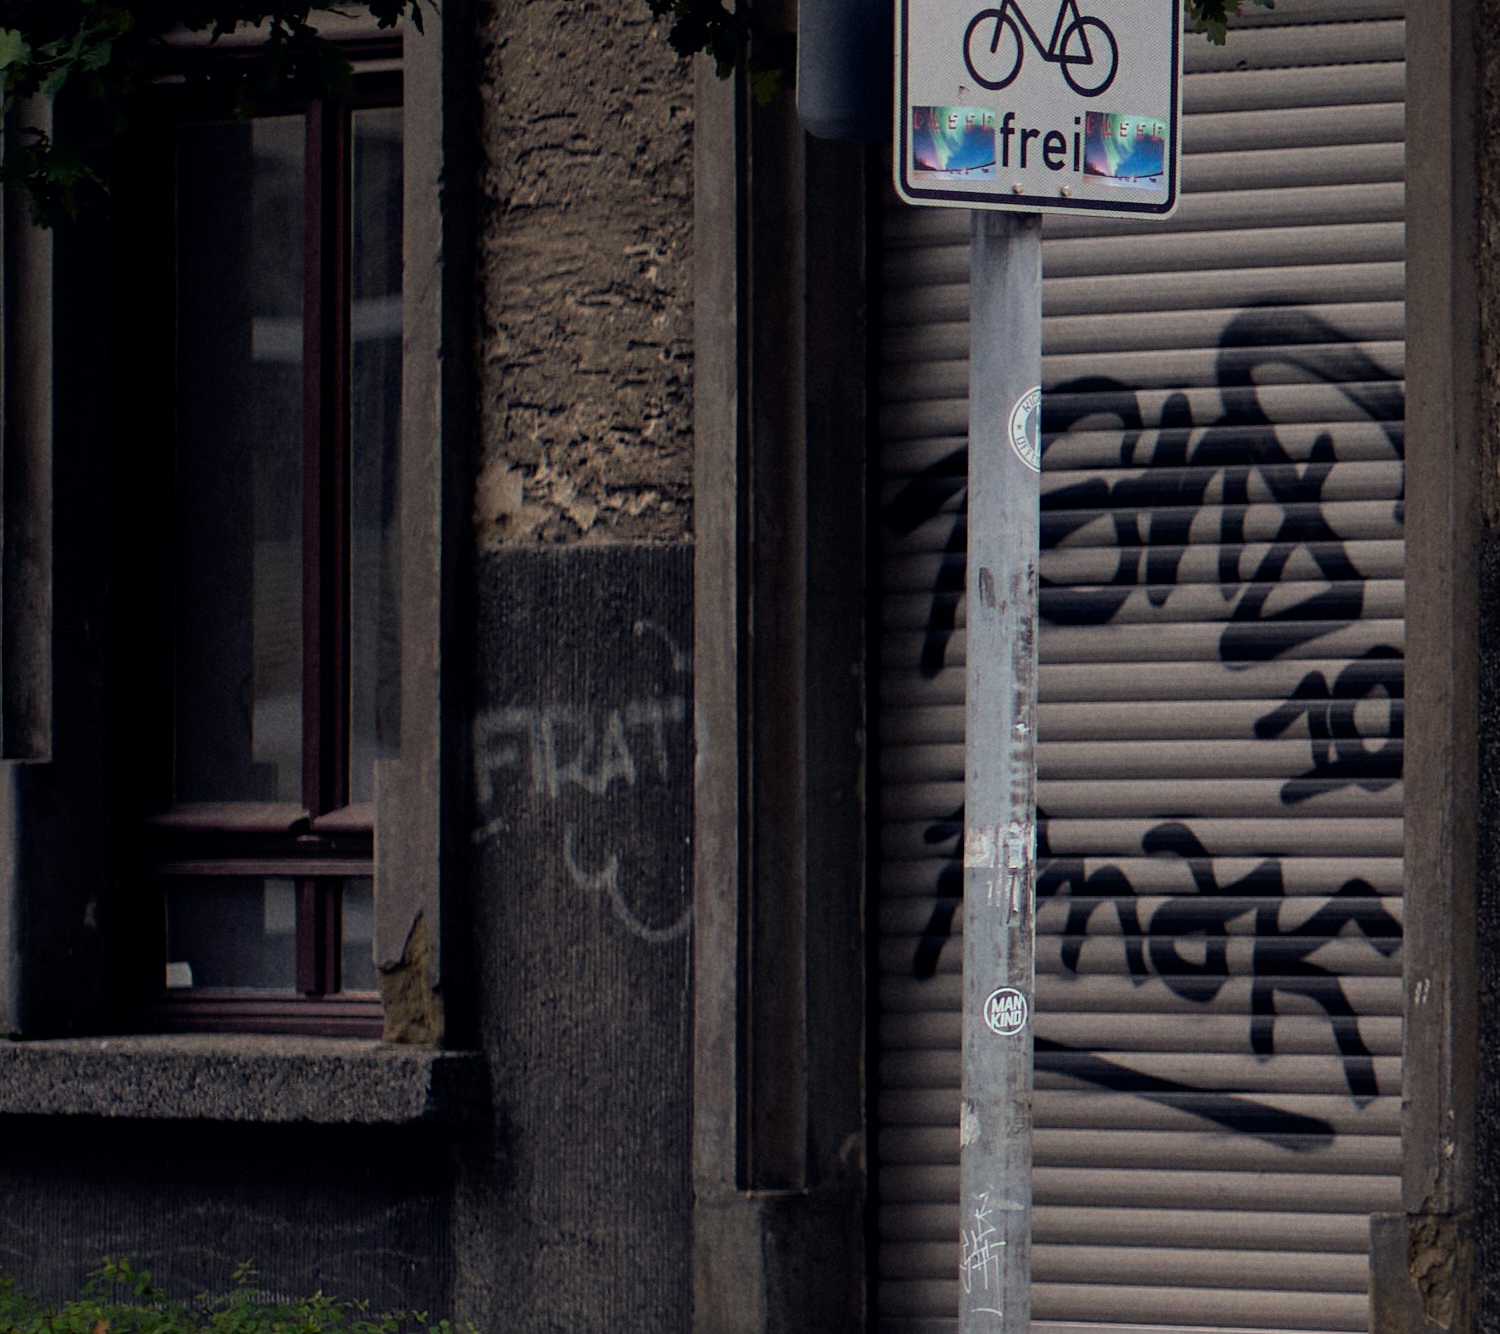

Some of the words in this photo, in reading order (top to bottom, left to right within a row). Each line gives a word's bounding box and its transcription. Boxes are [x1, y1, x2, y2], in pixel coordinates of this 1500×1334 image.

[1000, 111, 1081, 172] frei
[991, 994, 1022, 1014] MAN
[990, 1009, 1022, 1029] KIND
